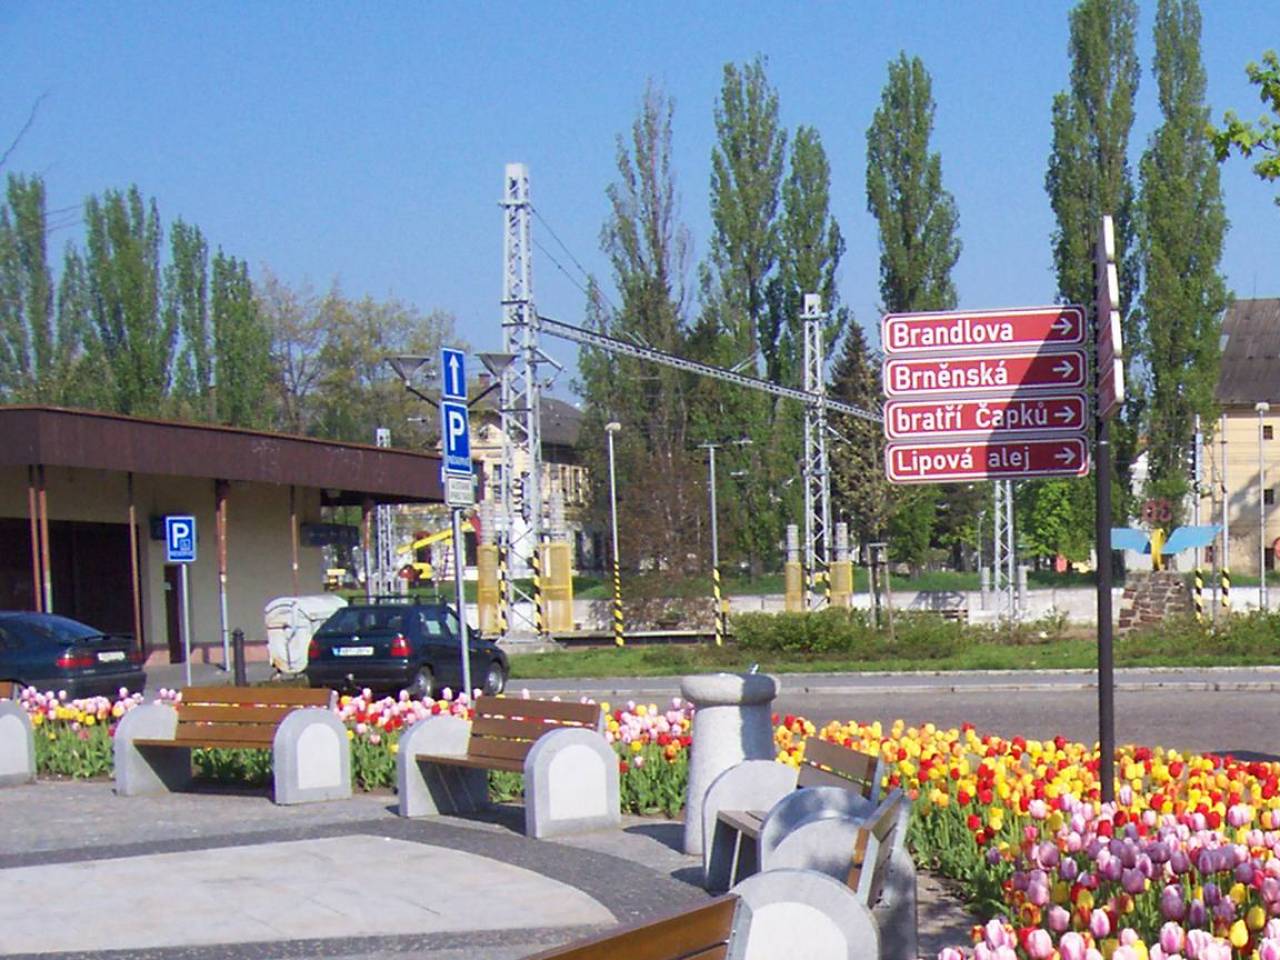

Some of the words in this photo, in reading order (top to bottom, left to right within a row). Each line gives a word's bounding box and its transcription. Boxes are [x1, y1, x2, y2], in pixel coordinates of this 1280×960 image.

[893, 320, 1013, 347] Brandlova
[895, 361, 1008, 389] Brněnská
[897, 403, 962, 431] bratří
[975, 401, 1048, 430] Čapků
[448, 411, 465, 451] P
[898, 447, 974, 476] Lipová
[988, 446, 1030, 471] alej
[172, 523, 189, 548] P
